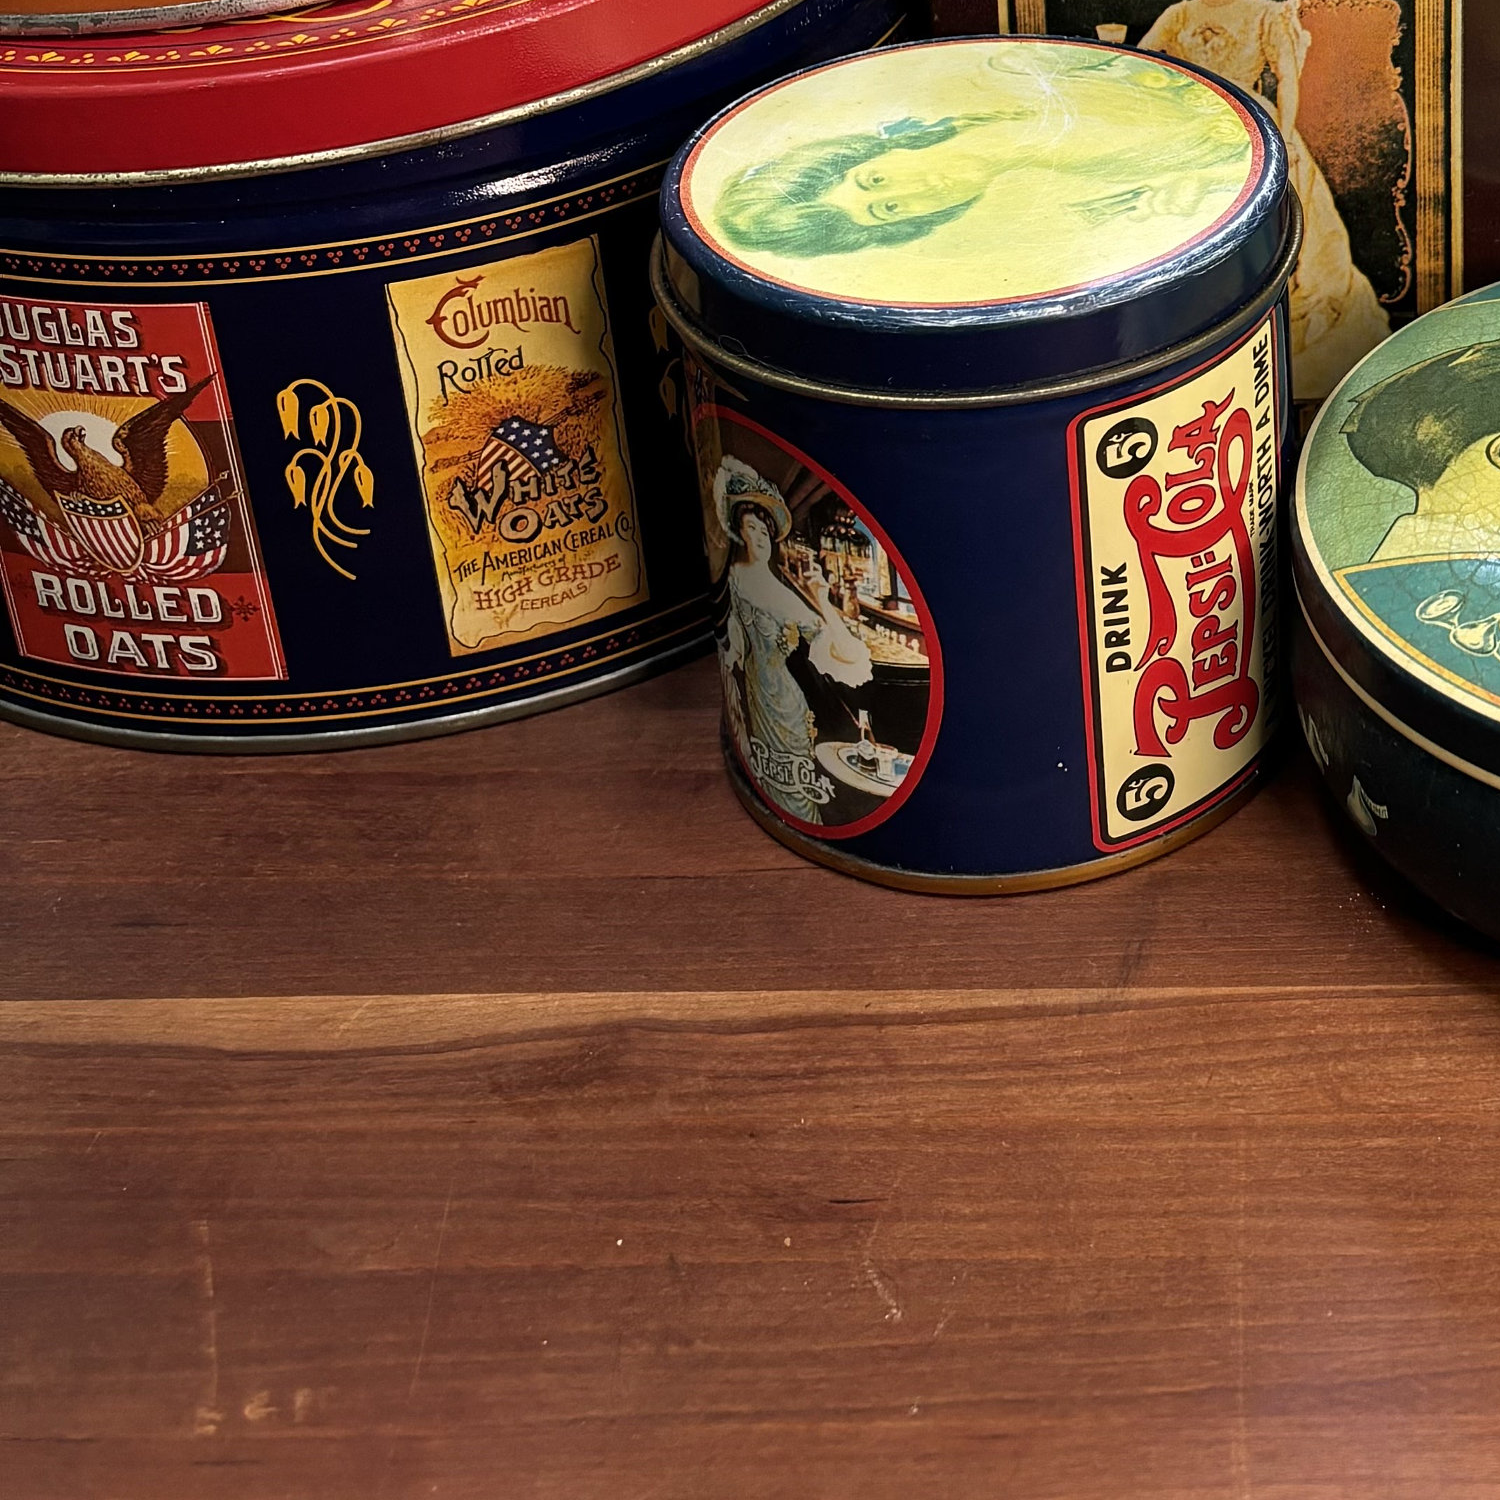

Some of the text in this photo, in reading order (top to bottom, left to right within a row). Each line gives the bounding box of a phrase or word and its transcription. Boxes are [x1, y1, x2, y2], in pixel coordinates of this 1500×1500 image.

[0, 303, 139, 348] UGLAS
[425, 275, 582, 349] Columbian
[1253, 333, 1269, 408] DIME
[1256, 406, 1271, 431] A
[453, 559, 482, 583] THE
[480, 540, 563, 586] AMERICAN
[563, 523, 615, 552] CEREAL
[473, 553, 622, 610] HIGH GRADE
[32, 570, 223, 623] ROLLED
[520, 582, 588, 611] CEREALS
[1100, 561, 1132, 673] DRINK
[64, 623, 219, 672] OATS
